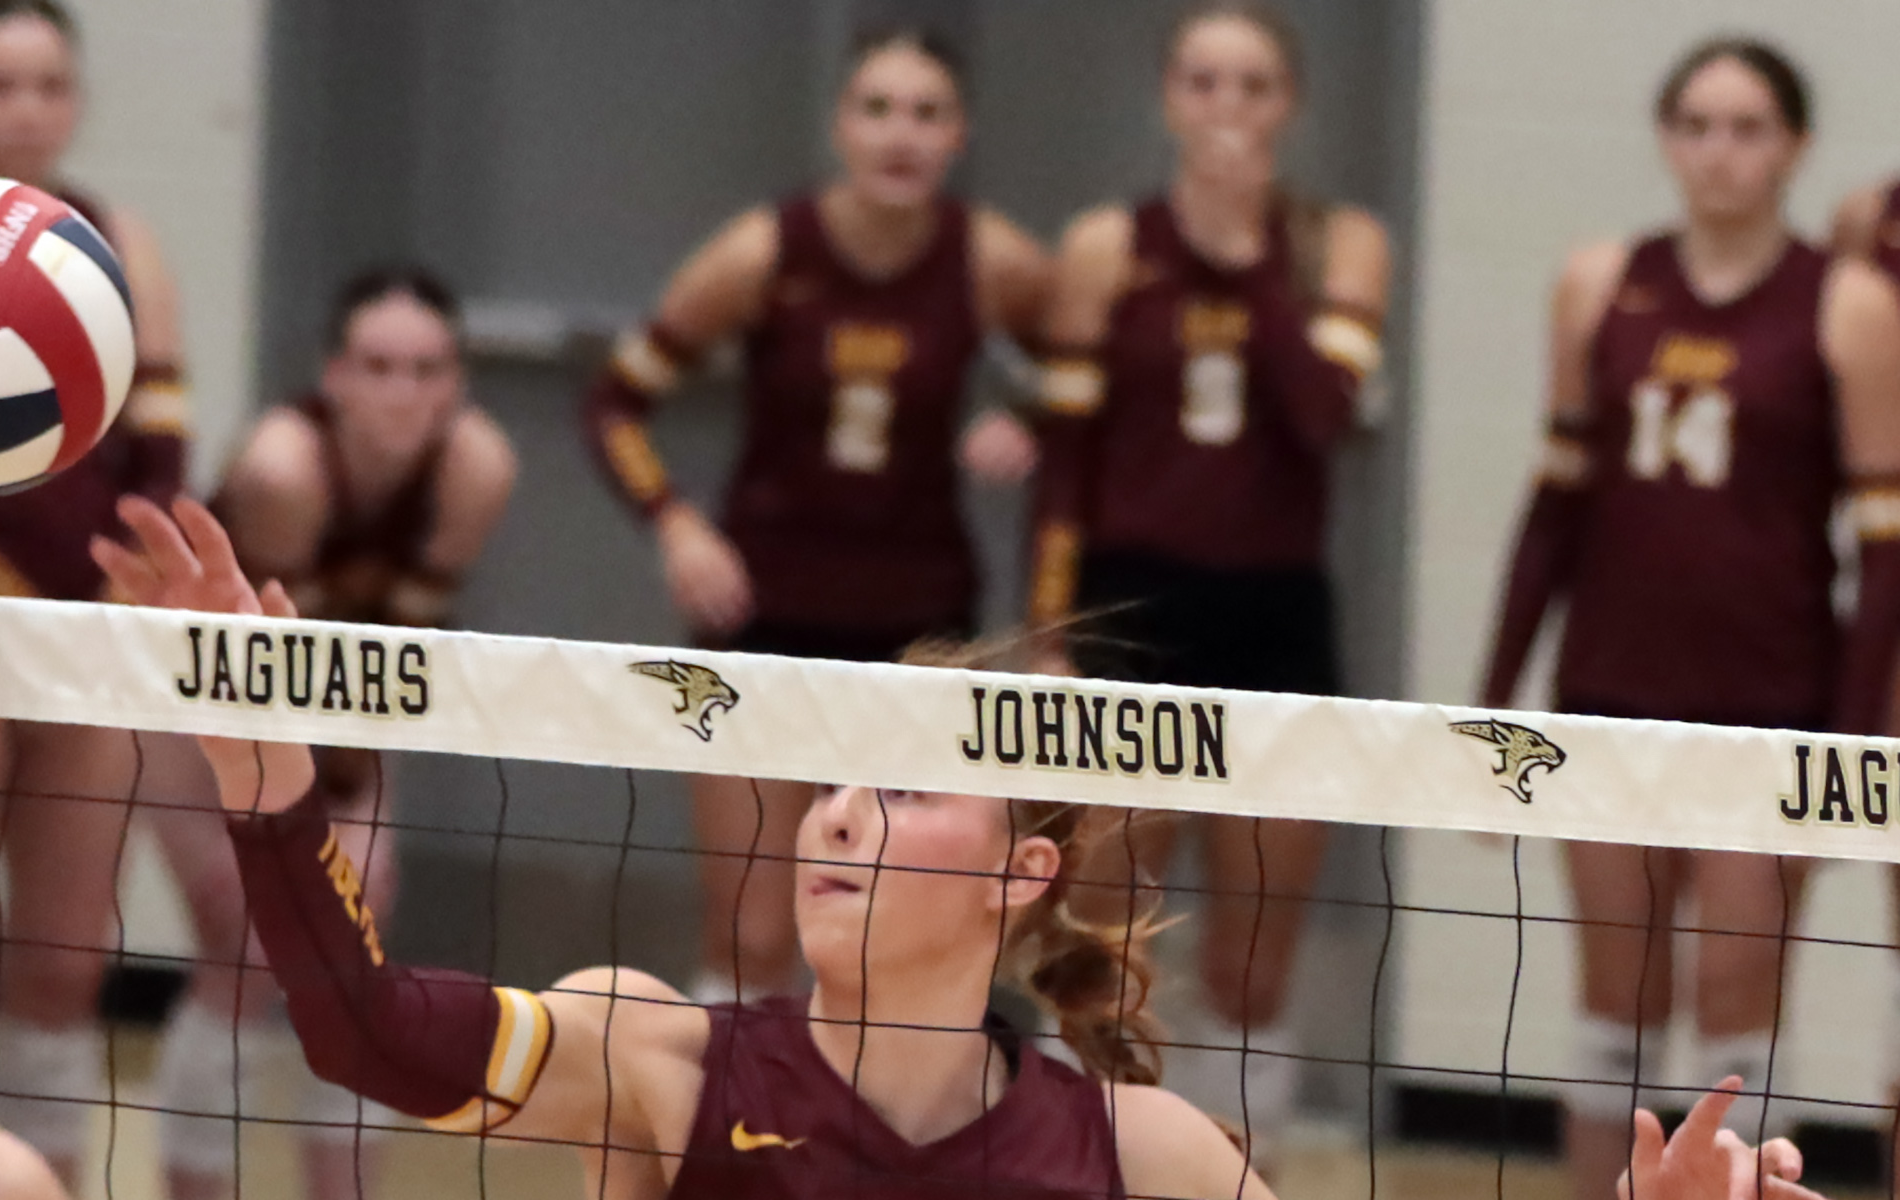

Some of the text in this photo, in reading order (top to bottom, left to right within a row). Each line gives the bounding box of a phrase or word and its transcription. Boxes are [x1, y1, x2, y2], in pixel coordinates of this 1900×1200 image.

[178, 626, 428, 715] JAGUARS
[962, 687, 1227, 778] JOHNSON
[1780, 744, 1900, 826] JAG
